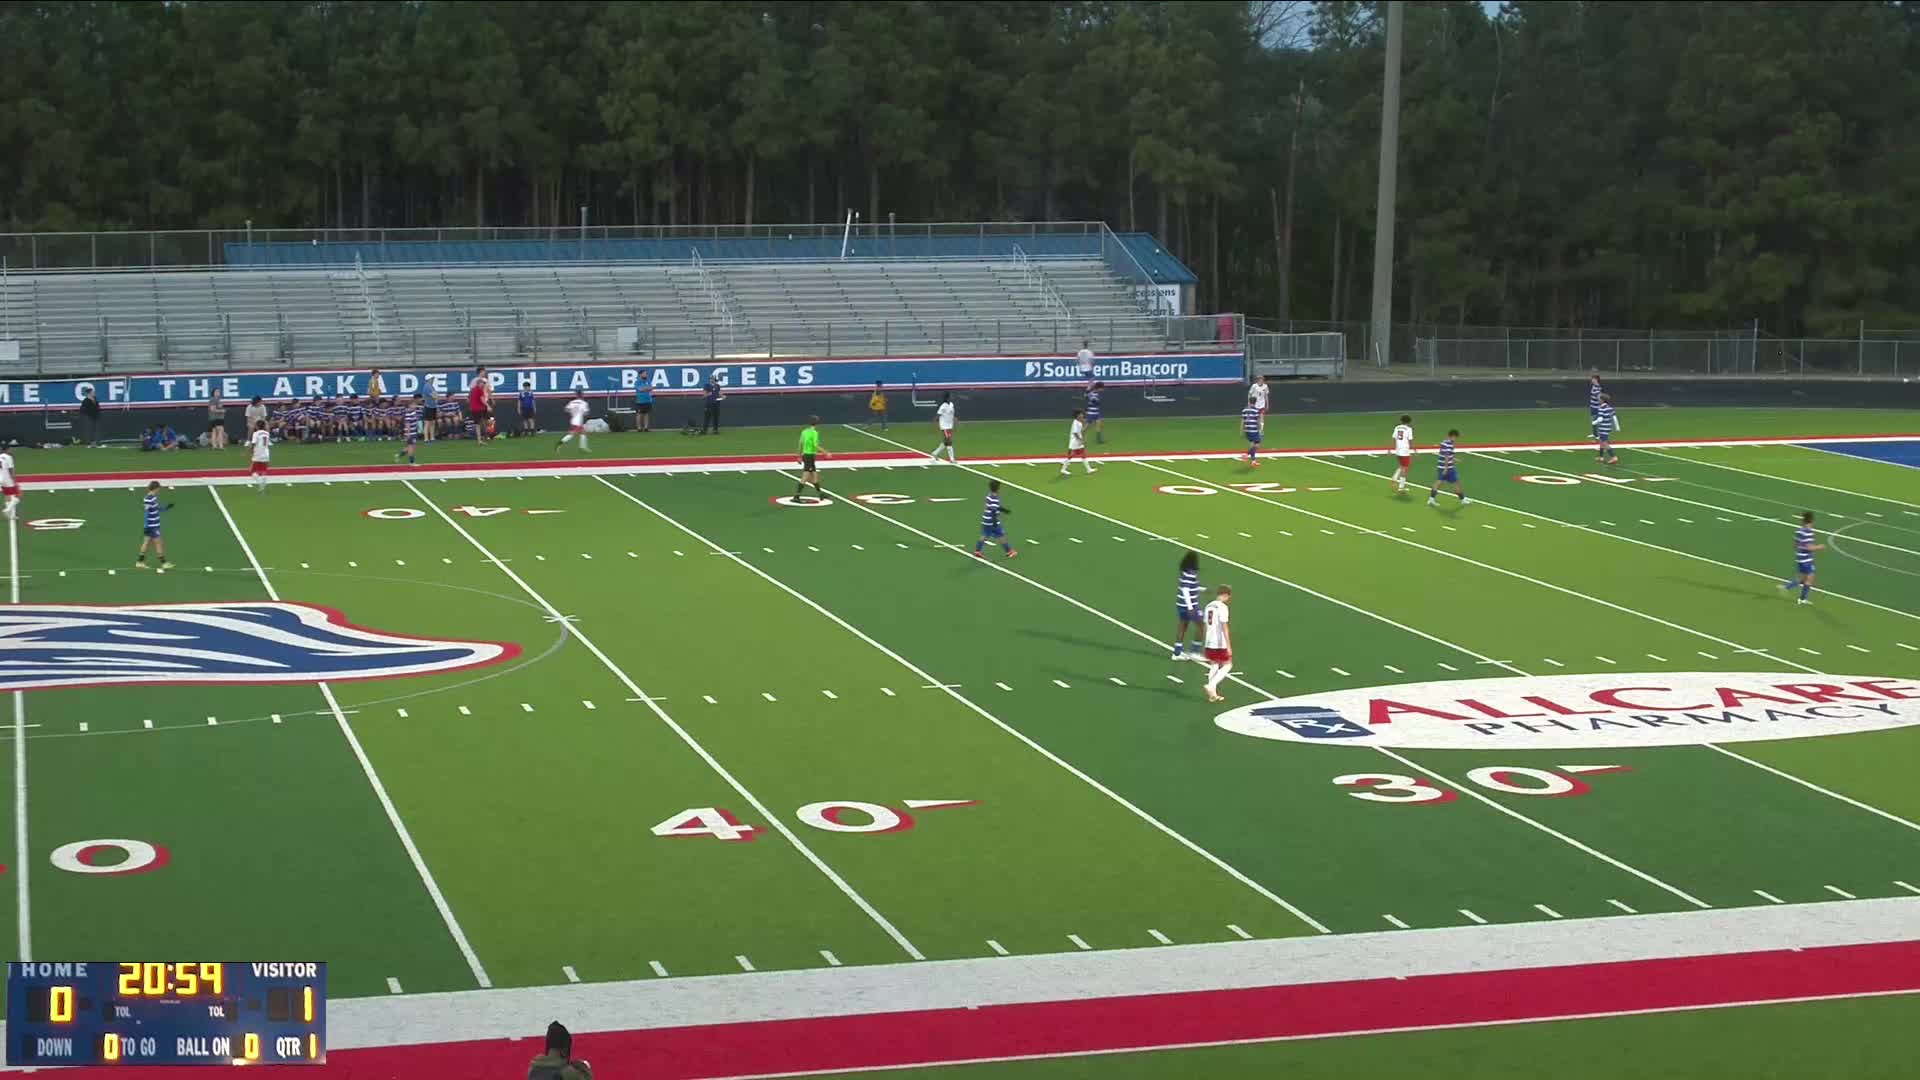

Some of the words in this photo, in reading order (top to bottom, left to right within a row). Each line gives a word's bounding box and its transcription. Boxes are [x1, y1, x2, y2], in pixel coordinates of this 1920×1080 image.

[74, 380, 125, 401] OF
[159, 377, 243, 399] THE
[621, 365, 814, 388] BADGERS
[1043, 361, 1187, 377] SouternBancorp
[1368, 679, 1920, 724] ALLCARE
[1463, 702, 1901, 735] PHARMACY
